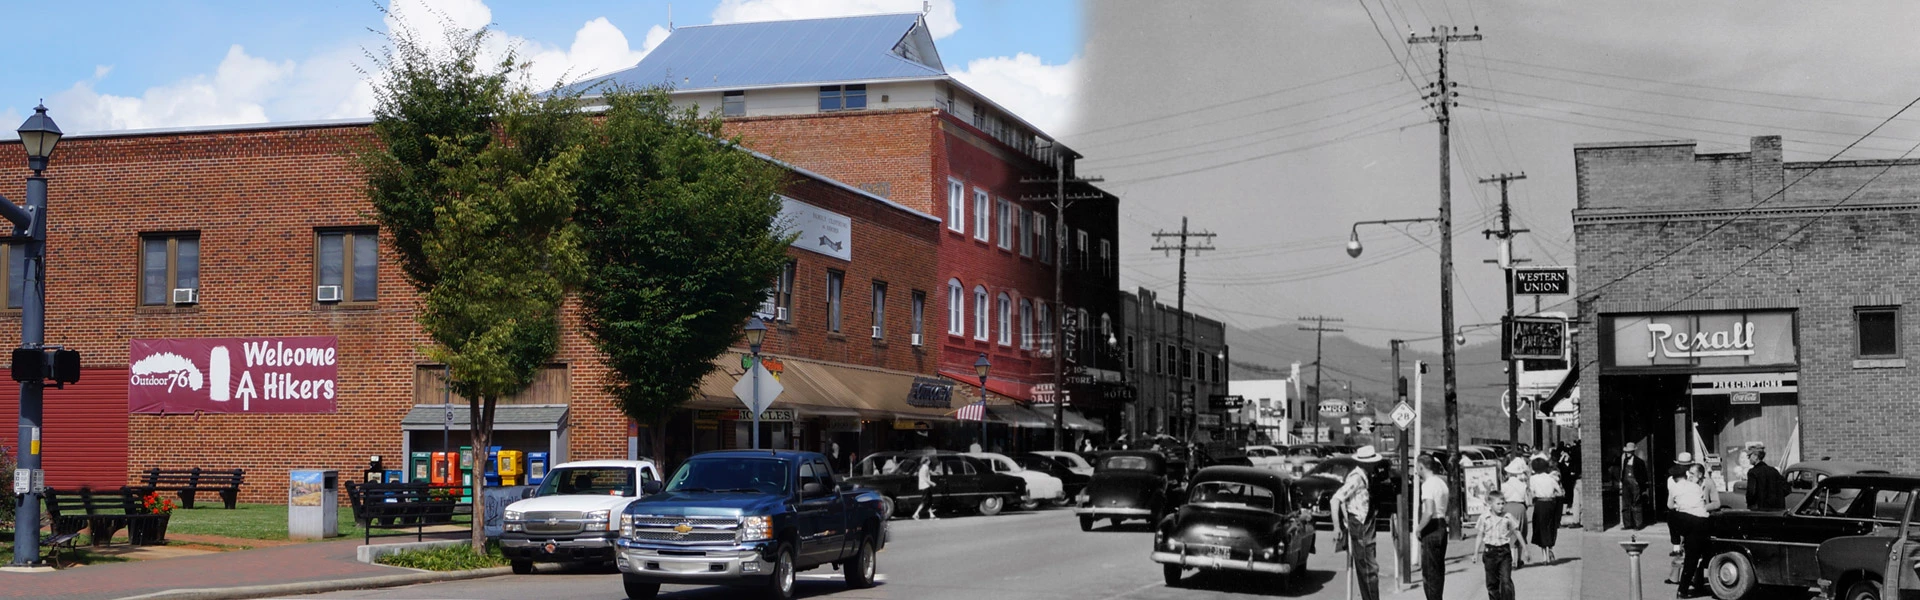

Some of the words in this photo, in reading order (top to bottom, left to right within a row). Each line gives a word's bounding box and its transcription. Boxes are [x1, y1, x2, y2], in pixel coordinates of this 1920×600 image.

[1517, 272, 1565, 281] WESTERN
[1524, 282, 1560, 292] UNION
[1647, 321, 1755, 358] Rexall
[243, 340, 336, 368] Welcome
[263, 372, 335, 400] Hikers
[1712, 380, 1783, 389] PRESCRIPTIONS
[1103, 390, 1133, 399] HOTEL
[1320, 404, 1348, 413] AMOCO
[739, 409, 791, 421] ICCLES
[1397, 413, 1410, 421] 28
